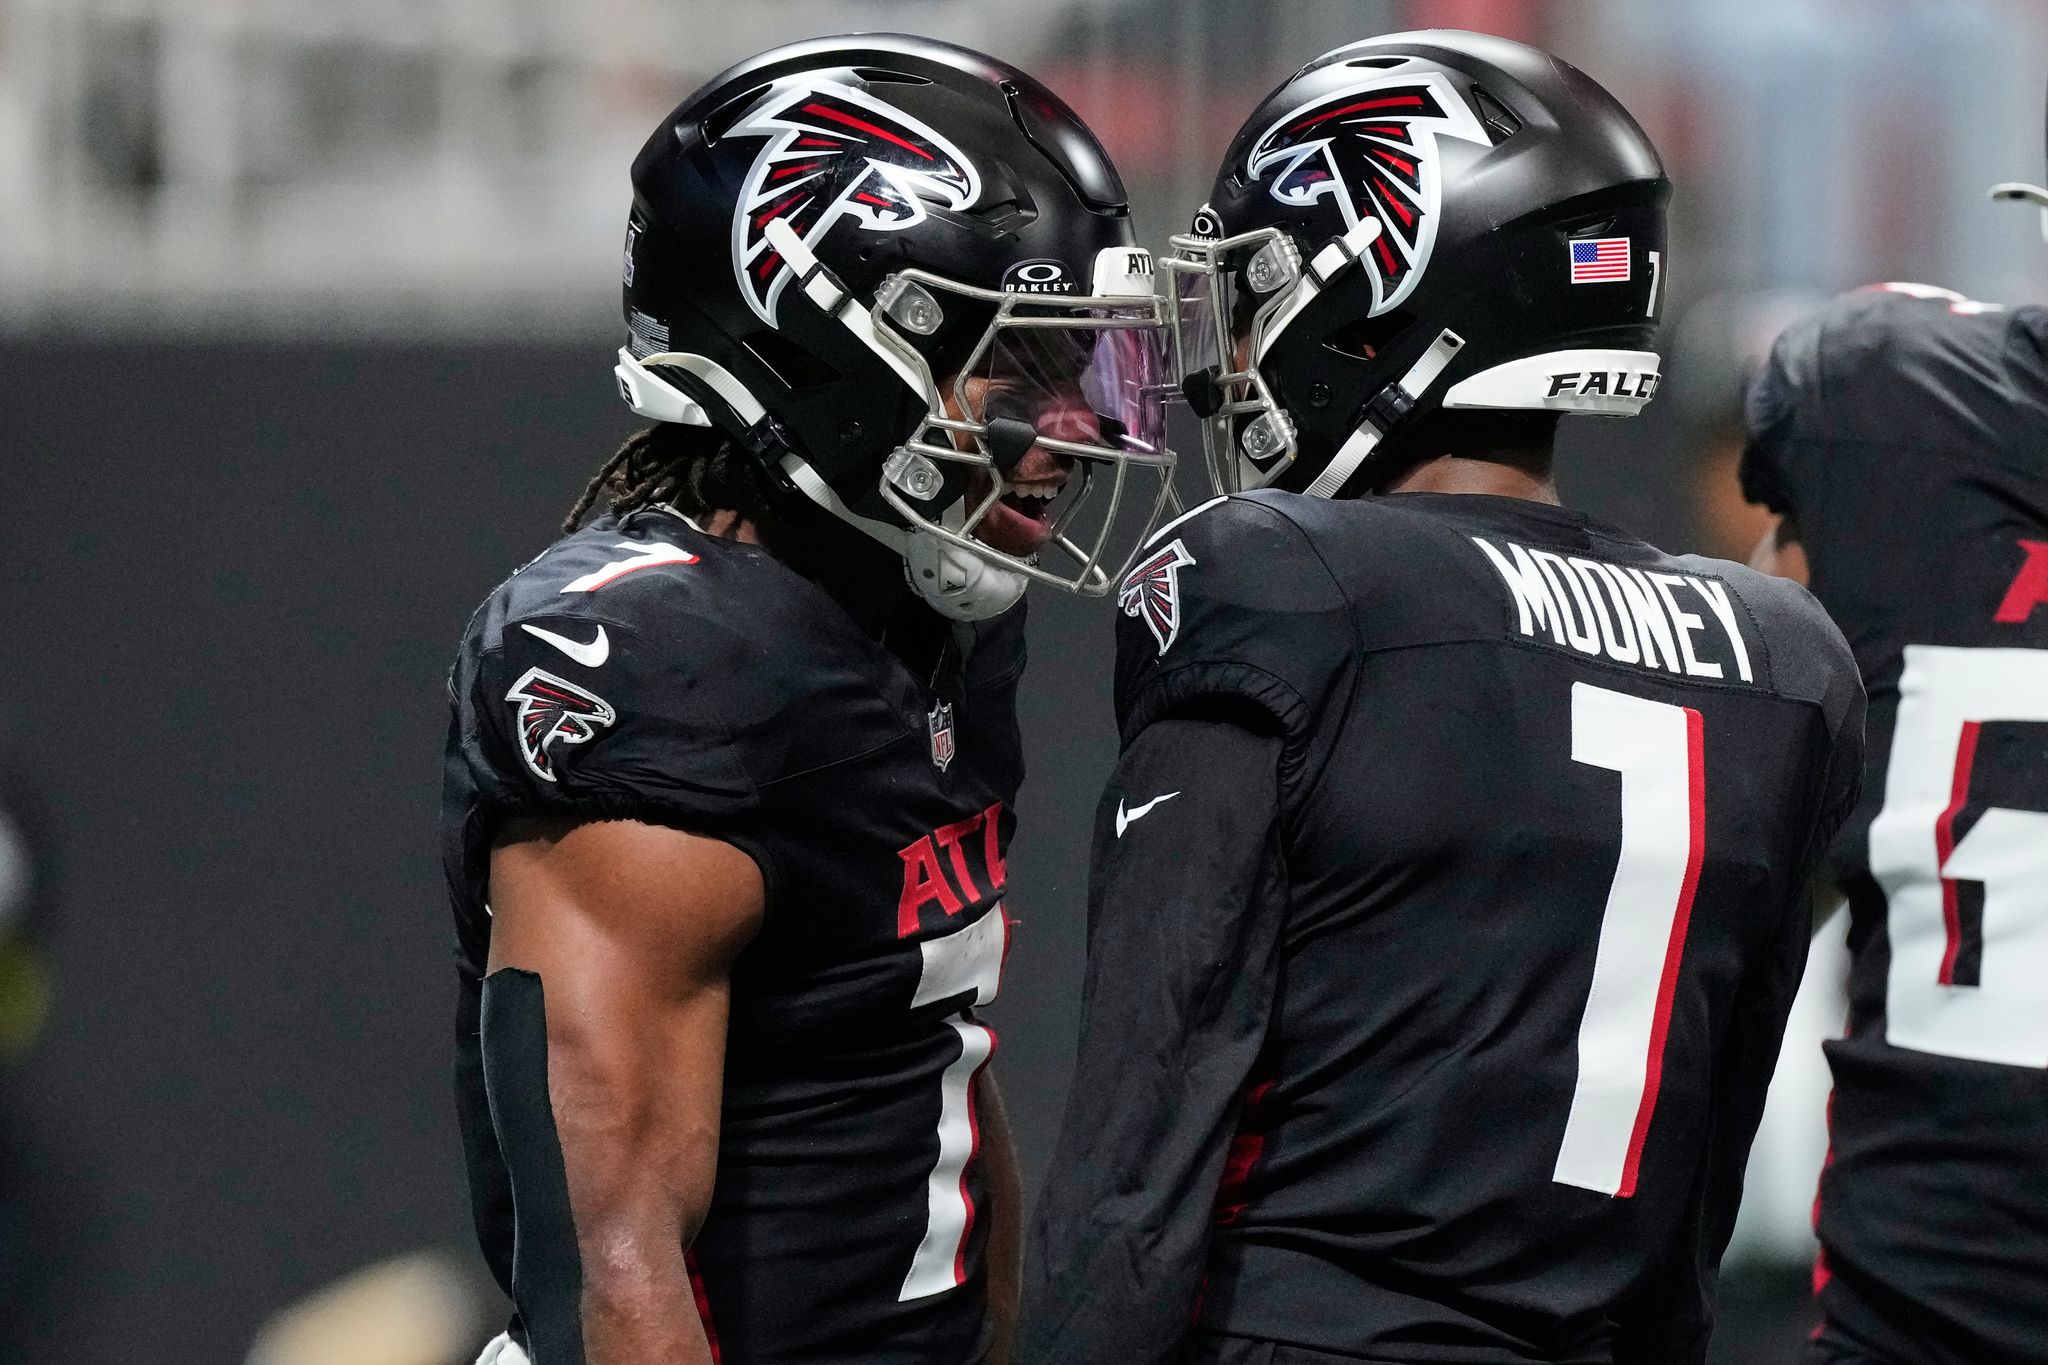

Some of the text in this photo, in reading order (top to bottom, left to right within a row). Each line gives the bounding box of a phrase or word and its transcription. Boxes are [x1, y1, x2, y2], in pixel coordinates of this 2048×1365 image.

[1005, 283, 1072, 292] OAKLEY
[1646, 251, 1660, 317] 1
[560, 541, 700, 594] 7
[1471, 537, 1754, 684] MOONEY
[1552, 681, 1705, 1198] 1
[899, 900, 1010, 1302] 7
